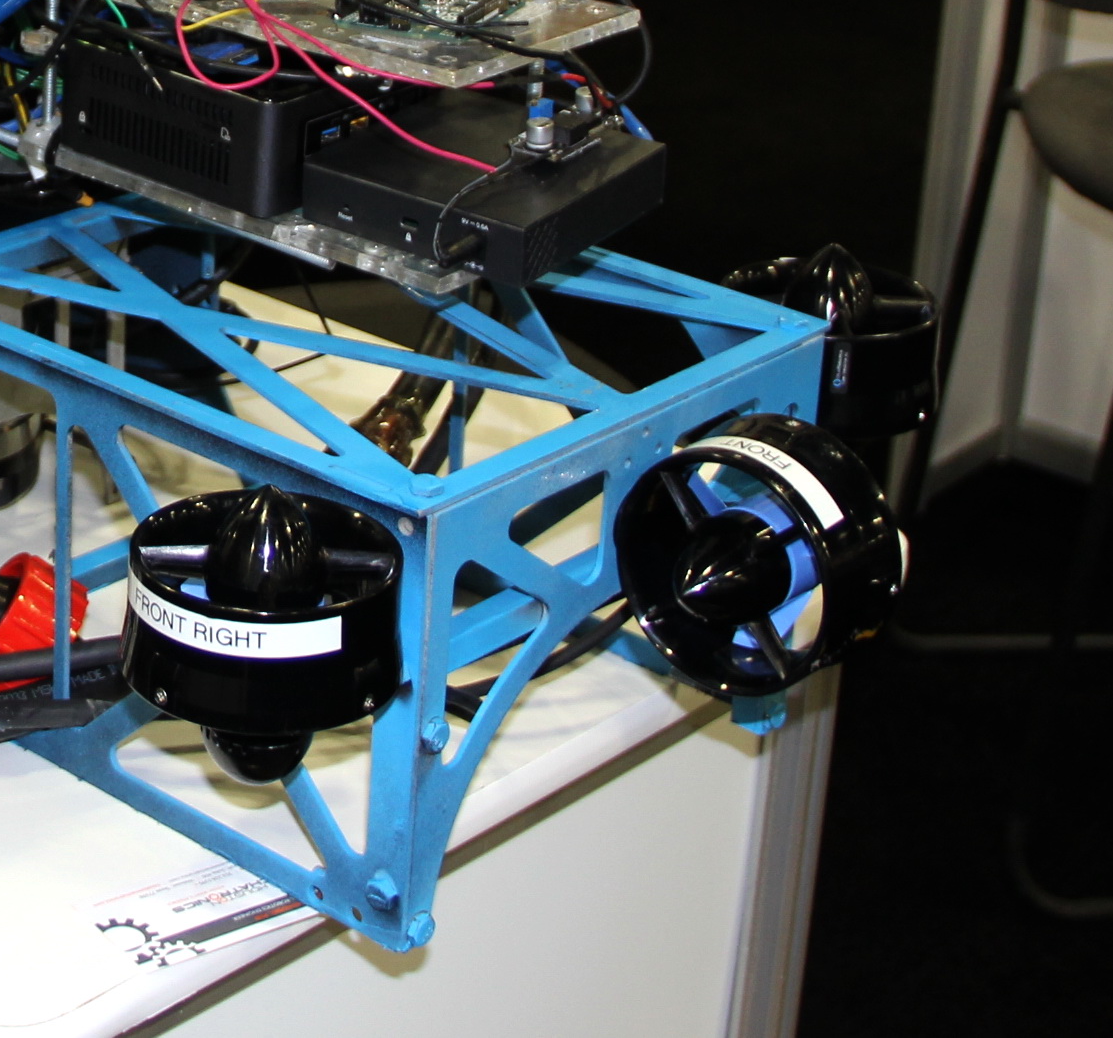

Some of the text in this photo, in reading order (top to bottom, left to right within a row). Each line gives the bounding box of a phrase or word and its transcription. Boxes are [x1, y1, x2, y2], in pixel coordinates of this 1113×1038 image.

[719, 438, 791, 471] FRONT
[135, 587, 267, 650] FRONT RIGHT
